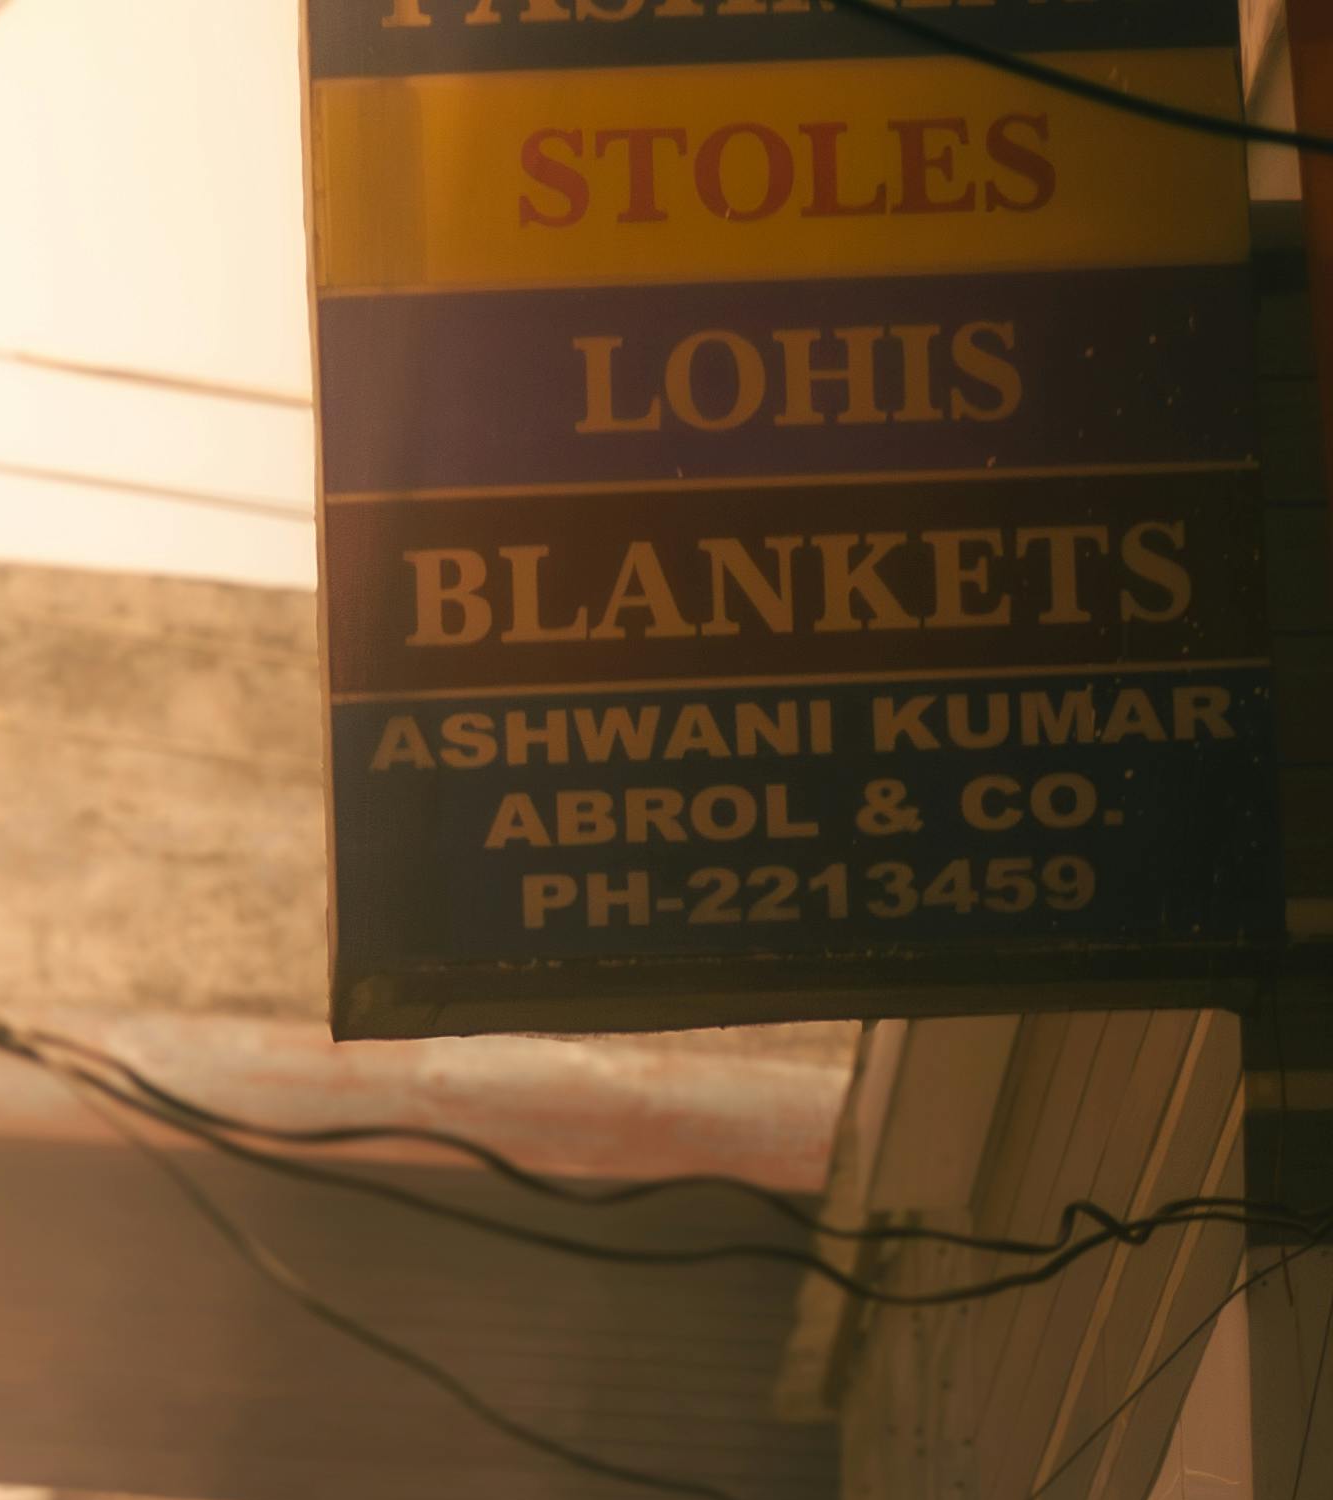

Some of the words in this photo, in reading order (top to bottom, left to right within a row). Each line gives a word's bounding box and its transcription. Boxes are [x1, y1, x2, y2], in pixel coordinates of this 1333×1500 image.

[517, 112, 1057, 229] STOLES
[572, 320, 1023, 434] LOHIS
[402, 519, 1193, 647] BLANKETS
[370, 699, 833, 772] ASHWANI
[872, 685, 1235, 752] KUMAR
[483, 783, 819, 849] ABROL
[854, 778, 924, 836] &
[960, 771, 1124, 832] CO.
[521, 855, 1096, 929] PH-2213459
